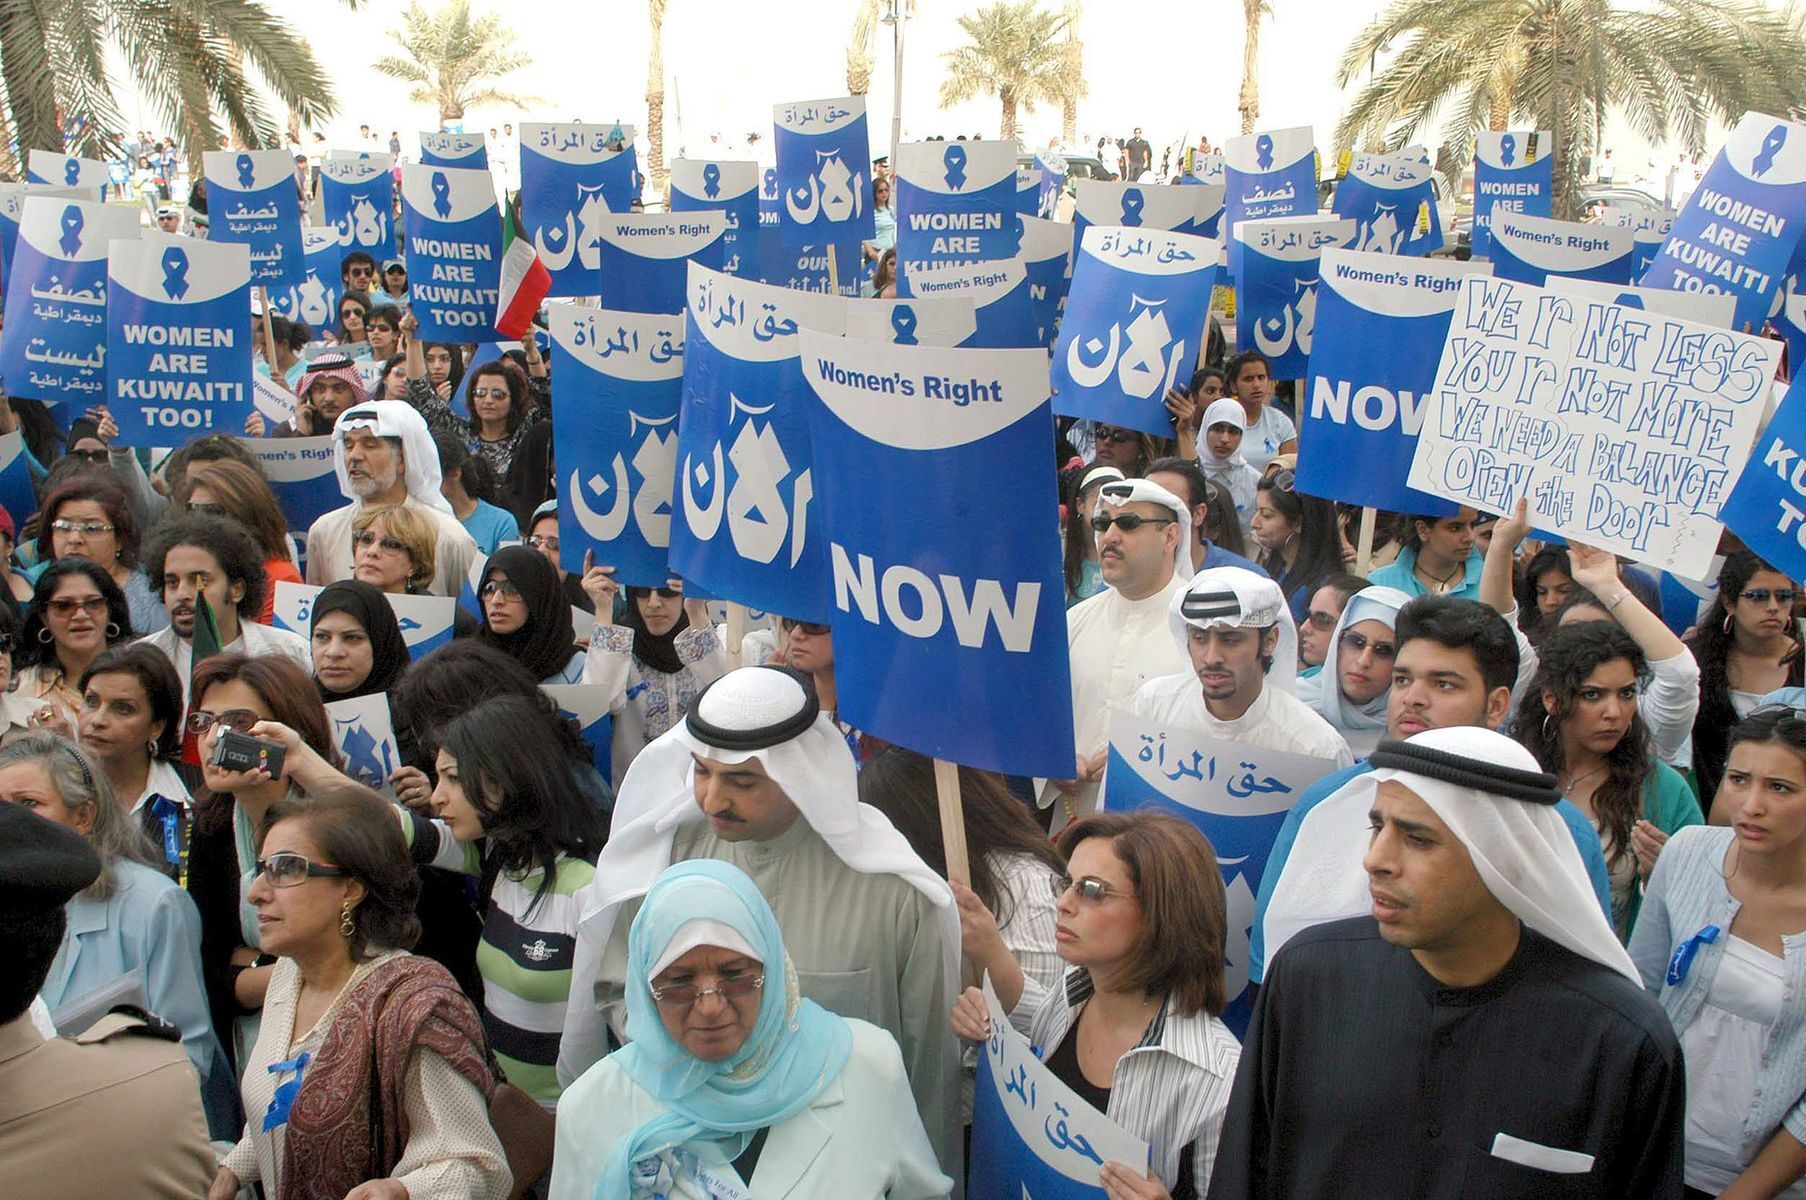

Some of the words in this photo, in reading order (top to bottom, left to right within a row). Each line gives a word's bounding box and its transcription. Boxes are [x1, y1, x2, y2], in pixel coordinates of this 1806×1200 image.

[1242, 180, 1296, 204] نصف
[1480, 182, 1539, 196] WOMEN
[225, 201, 279, 220] نصف
[1492, 200, 1524, 213] ARE
[1698, 189, 1785, 238] WOMEN
[616, 224, 675, 237] Women's
[680, 223, 710, 236] Right
[909, 213, 1001, 231] WOMEN
[412, 237, 492, 261] WOMEN
[931, 236, 980, 254] ARE
[1101, 232, 1152, 257] المرأة
[1504, 224, 1562, 246] Women's
[1567, 236, 1610, 252] Right
[1699, 223, 1751, 256] ARE
[1157, 242, 1195, 264] حق
[432, 264, 476, 283] ARE
[1336, 264, 1408, 286] Women's
[1665, 237, 1769, 294] KUWAITI
[31, 275, 106, 306] نصف
[920, 278, 970, 292] Women's
[973, 272, 1008, 287] Right
[413, 284, 498, 306] KUWAIT
[698, 279, 744, 328] المرأة
[33, 304, 102, 324] ديمقراطية
[430, 309, 487, 327] TOO!
[753, 303, 799, 341] حق
[123, 324, 234, 348] WOMEN
[574, 316, 639, 358] المرأة
[24, 338, 107, 376] ليست
[148, 353, 207, 374] ARE
[1576, 304, 1650, 371] NOT
[1652, 323, 1768, 404] LESS
[29, 371, 102, 392] ديمقراطية
[117, 379, 244, 402] KUWAITI
[818, 358, 915, 397] Women's
[923, 375, 1003, 407] Right
[1446, 338, 1515, 394] YOU
[1558, 368, 1630, 424] NOT
[141, 407, 213, 428] TOO!
[301, 448, 335, 462] Righ
[1440, 391, 1489, 444] WE
[1491, 408, 1564, 461] NEED
[1552, 433, 1584, 475] A
[1588, 433, 1729, 518] BALANCE
[831, 542, 1041, 653] NOW
[1138, 733, 1215, 782] المرأة
[1226, 761, 1292, 798] حق
[992, 1018, 1036, 1110] المرأة
[1045, 1101, 1104, 1165] حق
